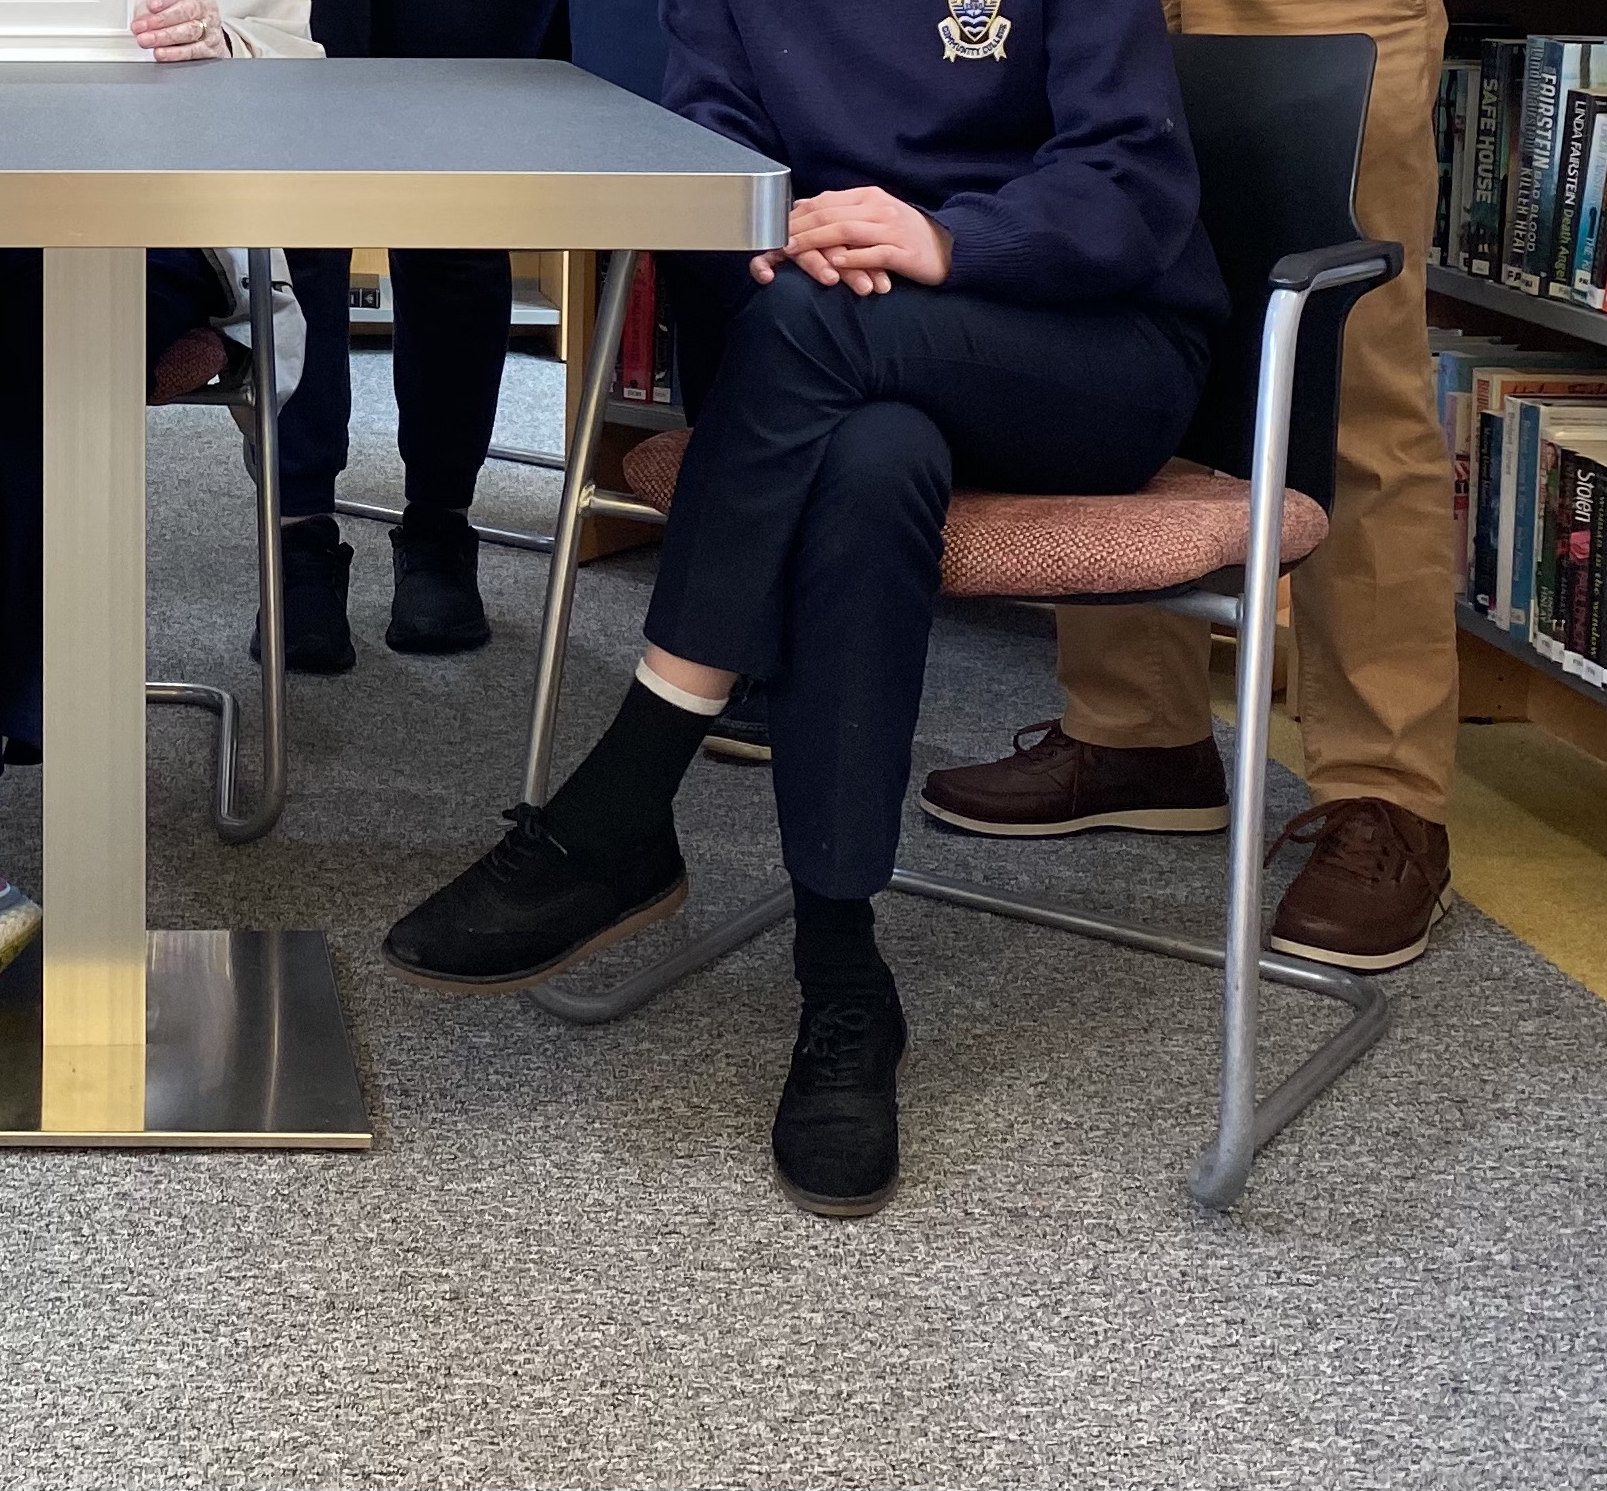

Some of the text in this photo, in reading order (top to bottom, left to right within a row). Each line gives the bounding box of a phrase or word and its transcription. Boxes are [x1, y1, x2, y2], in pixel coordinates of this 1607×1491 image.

[1476, 79, 1498, 204] SAFE HOUSE
[1533, 73, 1557, 170] FAIRSTEIN
[1517, 167, 1533, 214] KILLER
[1555, 100, 1586, 281] LINDA FAIRSTEIN Death Angel
[1574, 469, 1595, 522] Stolen
[1593, 572, 1603, 596] the
[1590, 601, 1601, 658] window
